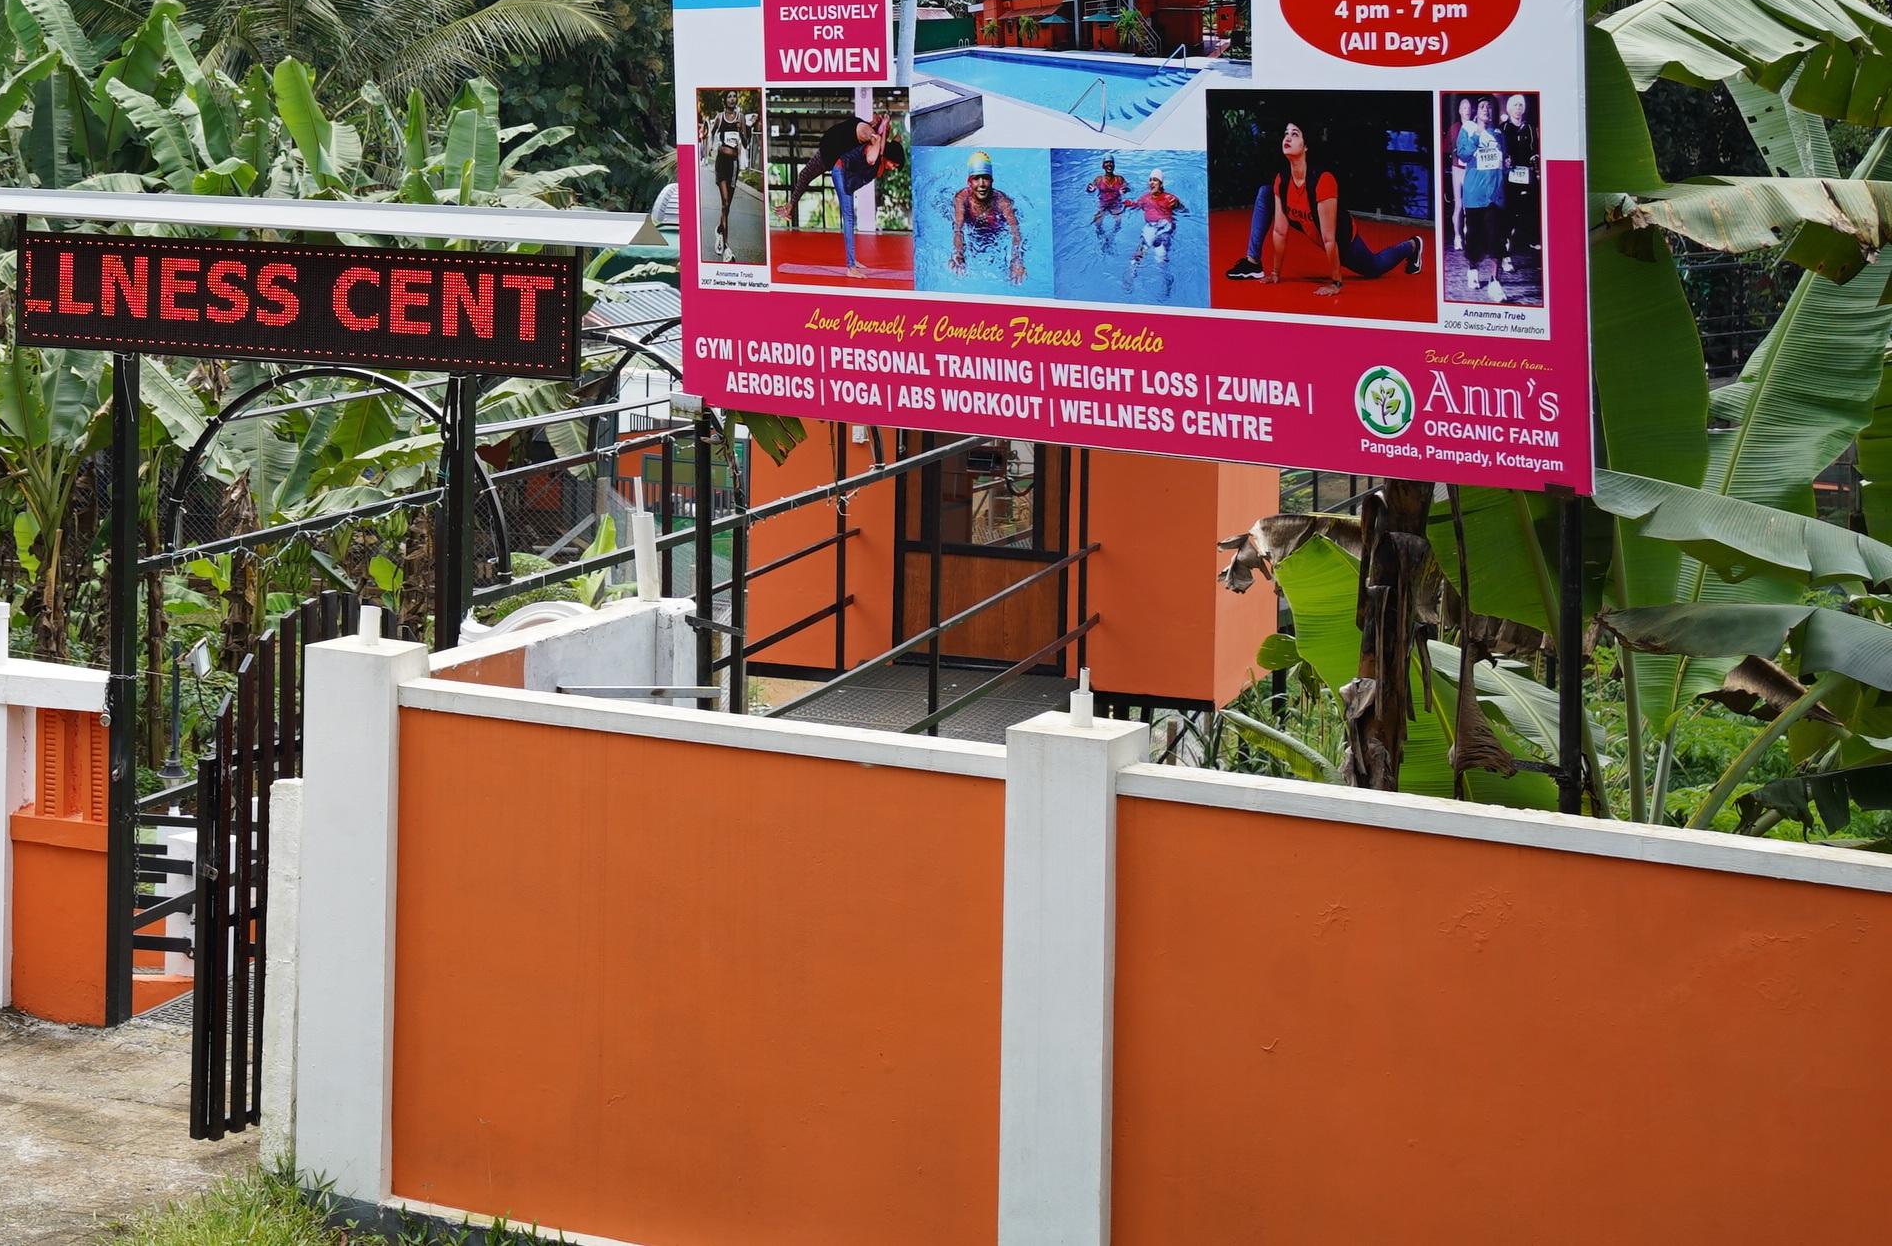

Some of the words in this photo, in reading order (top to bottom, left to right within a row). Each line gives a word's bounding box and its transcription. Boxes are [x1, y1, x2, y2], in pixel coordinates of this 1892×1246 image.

[780, 4, 878, 21] EXCLUSIVELY
[1334, 1, 1348, 18] 4
[1356, 4, 1389, 23] pm
[1411, 0, 1424, 18] 7
[1432, 3, 1468, 22] pm
[814, 26, 844, 40] FOR
[1340, 32, 1377, 55] (All
[1385, 31, 1449, 55] Days)
[779, 48, 880, 73] WOMEN
[332, 268, 554, 342] CENT
[1463, 309, 1501, 319] Annamma
[1504, 311, 1526, 321] Trueb
[805, 308, 840, 330] Love
[844, 310, 906, 342] Yourself
[910, 315, 927, 337] A
[933, 316, 1004, 342] Complete
[1009, 316, 1082, 348] Fitness
[1091, 323, 1164, 352] Studio
[1444, 320, 1462, 329] 2006
[1463, 321, 1508, 333] Swiss-Zurich
[1511, 324, 1545, 335] Marathon
[1425, 349, 1449, 363] Best
[1452, 351, 1517, 369] Compliments
[696, 337, 732, 360] GYM
[747, 340, 814, 367] CARDIO
[831, 347, 930, 376] PERSONAL
[936, 354, 1033, 384] TRAINING
[1050, 363, 1134, 394] WEIGHT
[1142, 370, 1197, 398] LOSS
[1218, 376, 1300, 407] ZUMBA
[726, 372, 814, 400] AEROBICS
[830, 380, 881, 405] YOGA
[898, 385, 935, 410] ABS
[941, 388, 1042, 420] WORKOUT
[1060, 399, 1174, 432] WELLNESS
[1182, 410, 1273, 442] CENTRE
[1423, 369, 1559, 422] Ann's
[1424, 421, 1504, 442] ORGANIC
[1510, 428, 1559, 447] FARM
[1361, 439, 1422, 459] Pangada,
[1426, 445, 1492, 467] Pampady,
[1497, 452, 1564, 472] Kottayam
